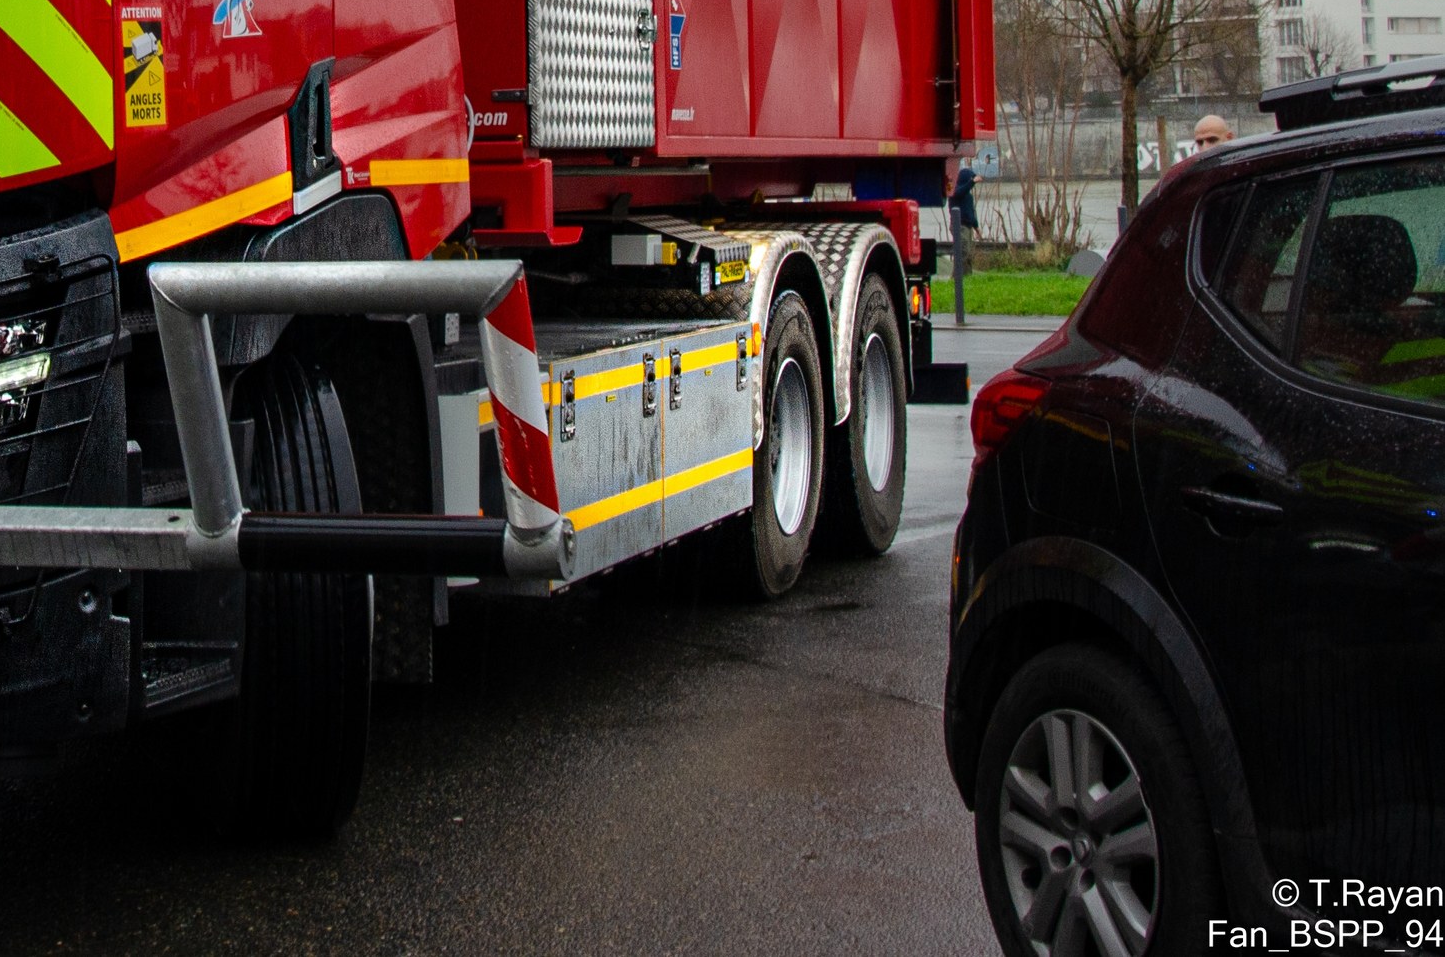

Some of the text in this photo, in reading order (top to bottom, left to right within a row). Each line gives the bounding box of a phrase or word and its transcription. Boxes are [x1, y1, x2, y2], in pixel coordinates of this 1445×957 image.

[121, 7, 162, 19] ATTENTION
[130, 93, 162, 106] ANGLES
[132, 107, 161, 120] MORTS
